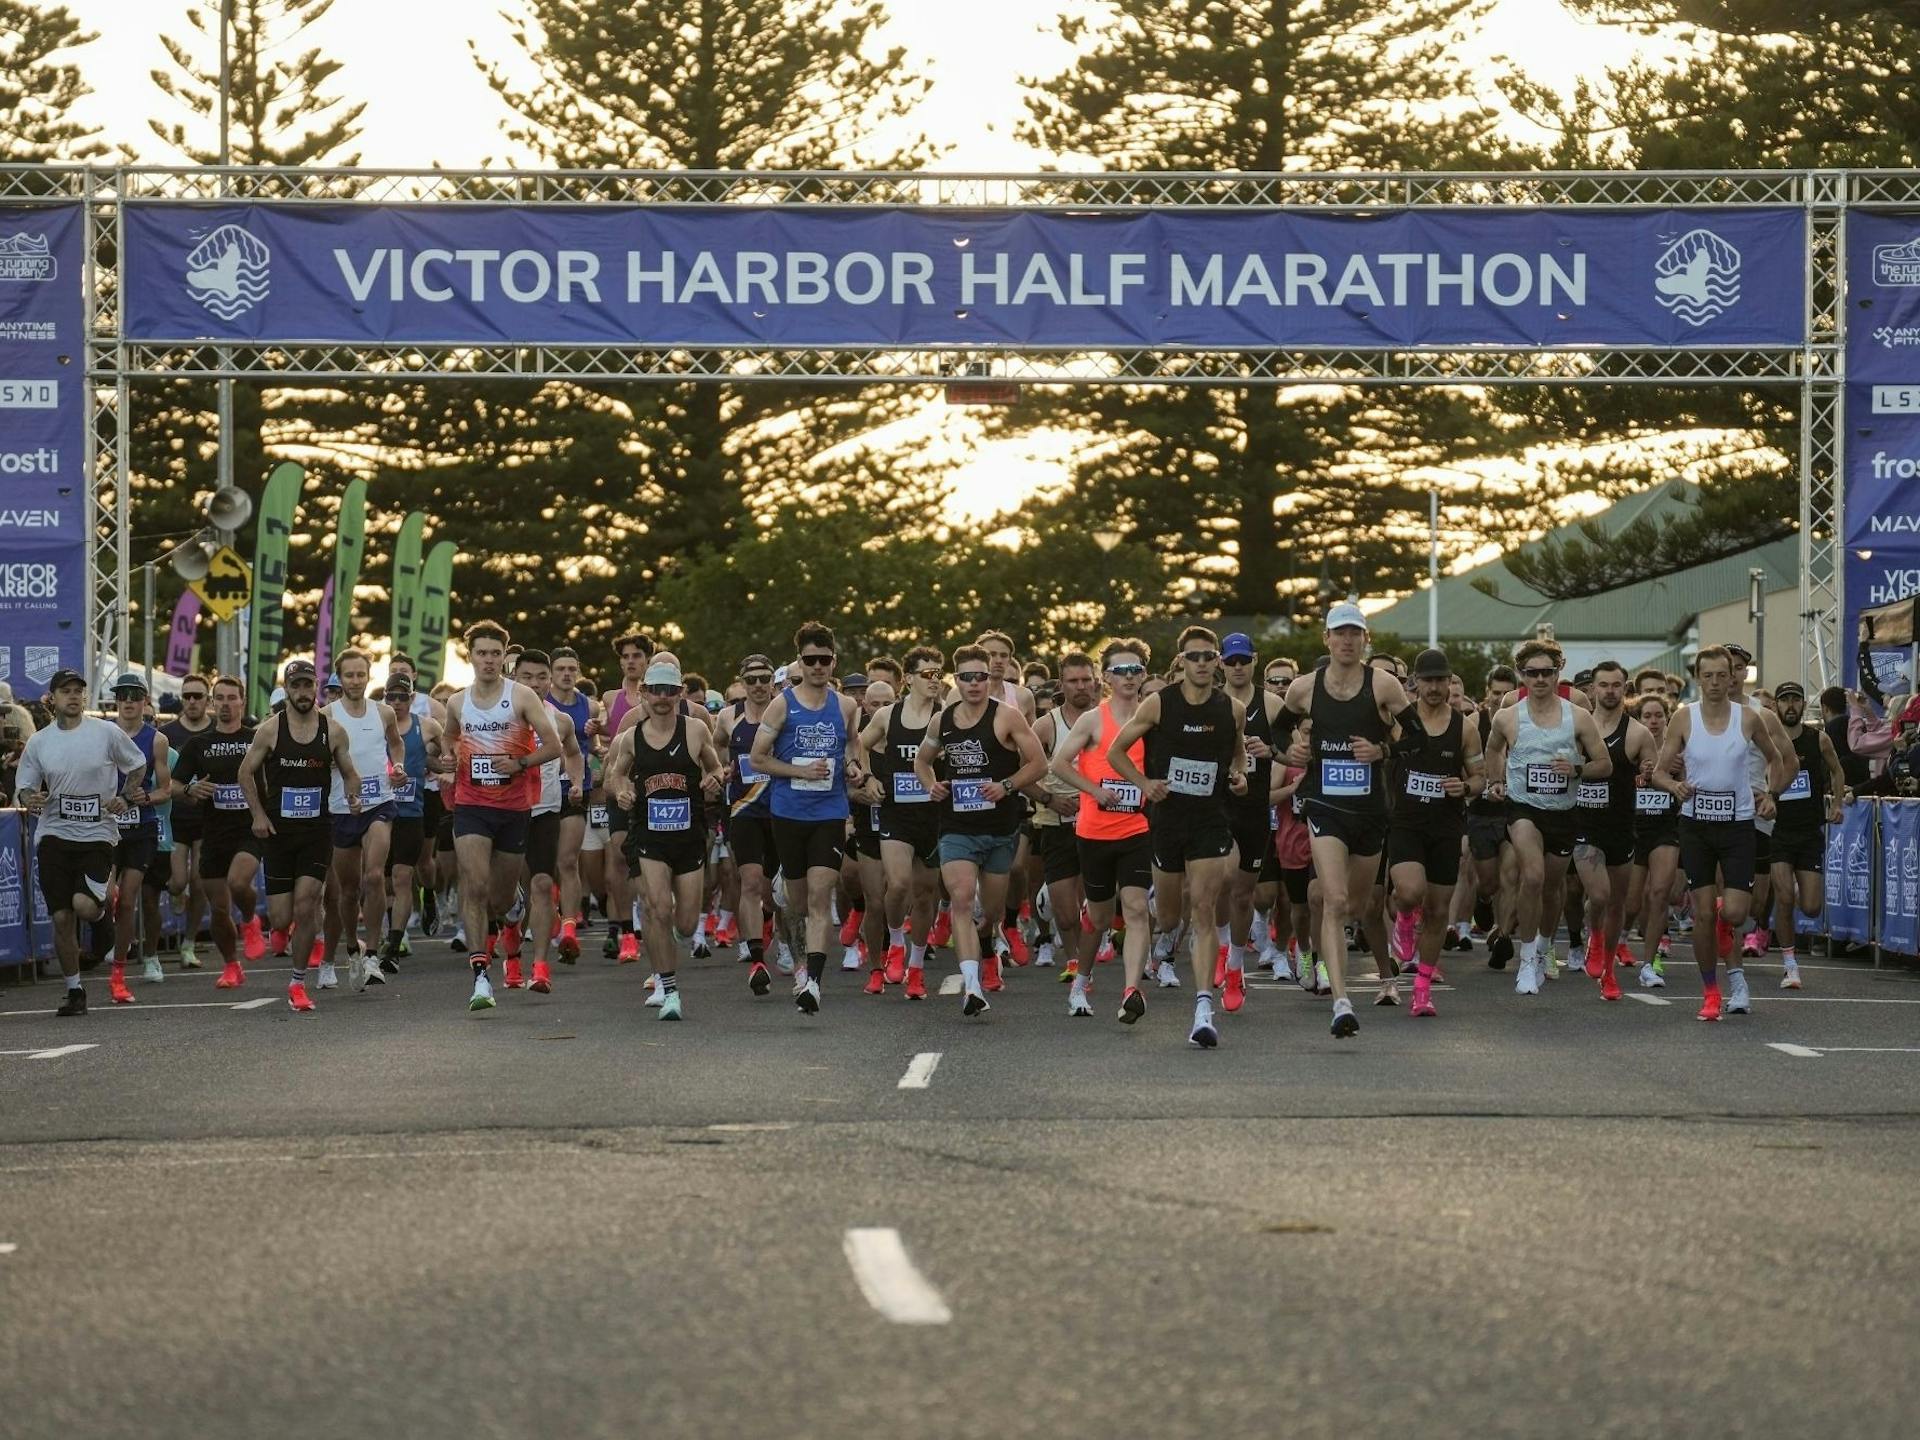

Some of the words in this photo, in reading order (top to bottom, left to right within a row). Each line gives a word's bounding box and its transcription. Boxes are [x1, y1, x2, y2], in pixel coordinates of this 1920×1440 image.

[333, 249, 601, 302] VICTOR
[628, 251, 936, 304] HARBOR
[961, 253, 1146, 305] HALF
[1170, 253, 1586, 306] MARATHON
[0, 322, 56, 331] ANYTIME
[0, 331, 56, 340] FITNESS
[1881, 391, 1920, 407] LS
[1174, 769, 1210, 786] 9153
[1328, 768, 1364, 781] 2198
[957, 785, 984, 799] 147
[294, 795, 311, 807] 82
[1639, 794, 1668, 805] 3727
[1697, 798, 1732, 811] 3509
[65, 801, 95, 813] 3617
[653, 806, 685, 818] 1477
